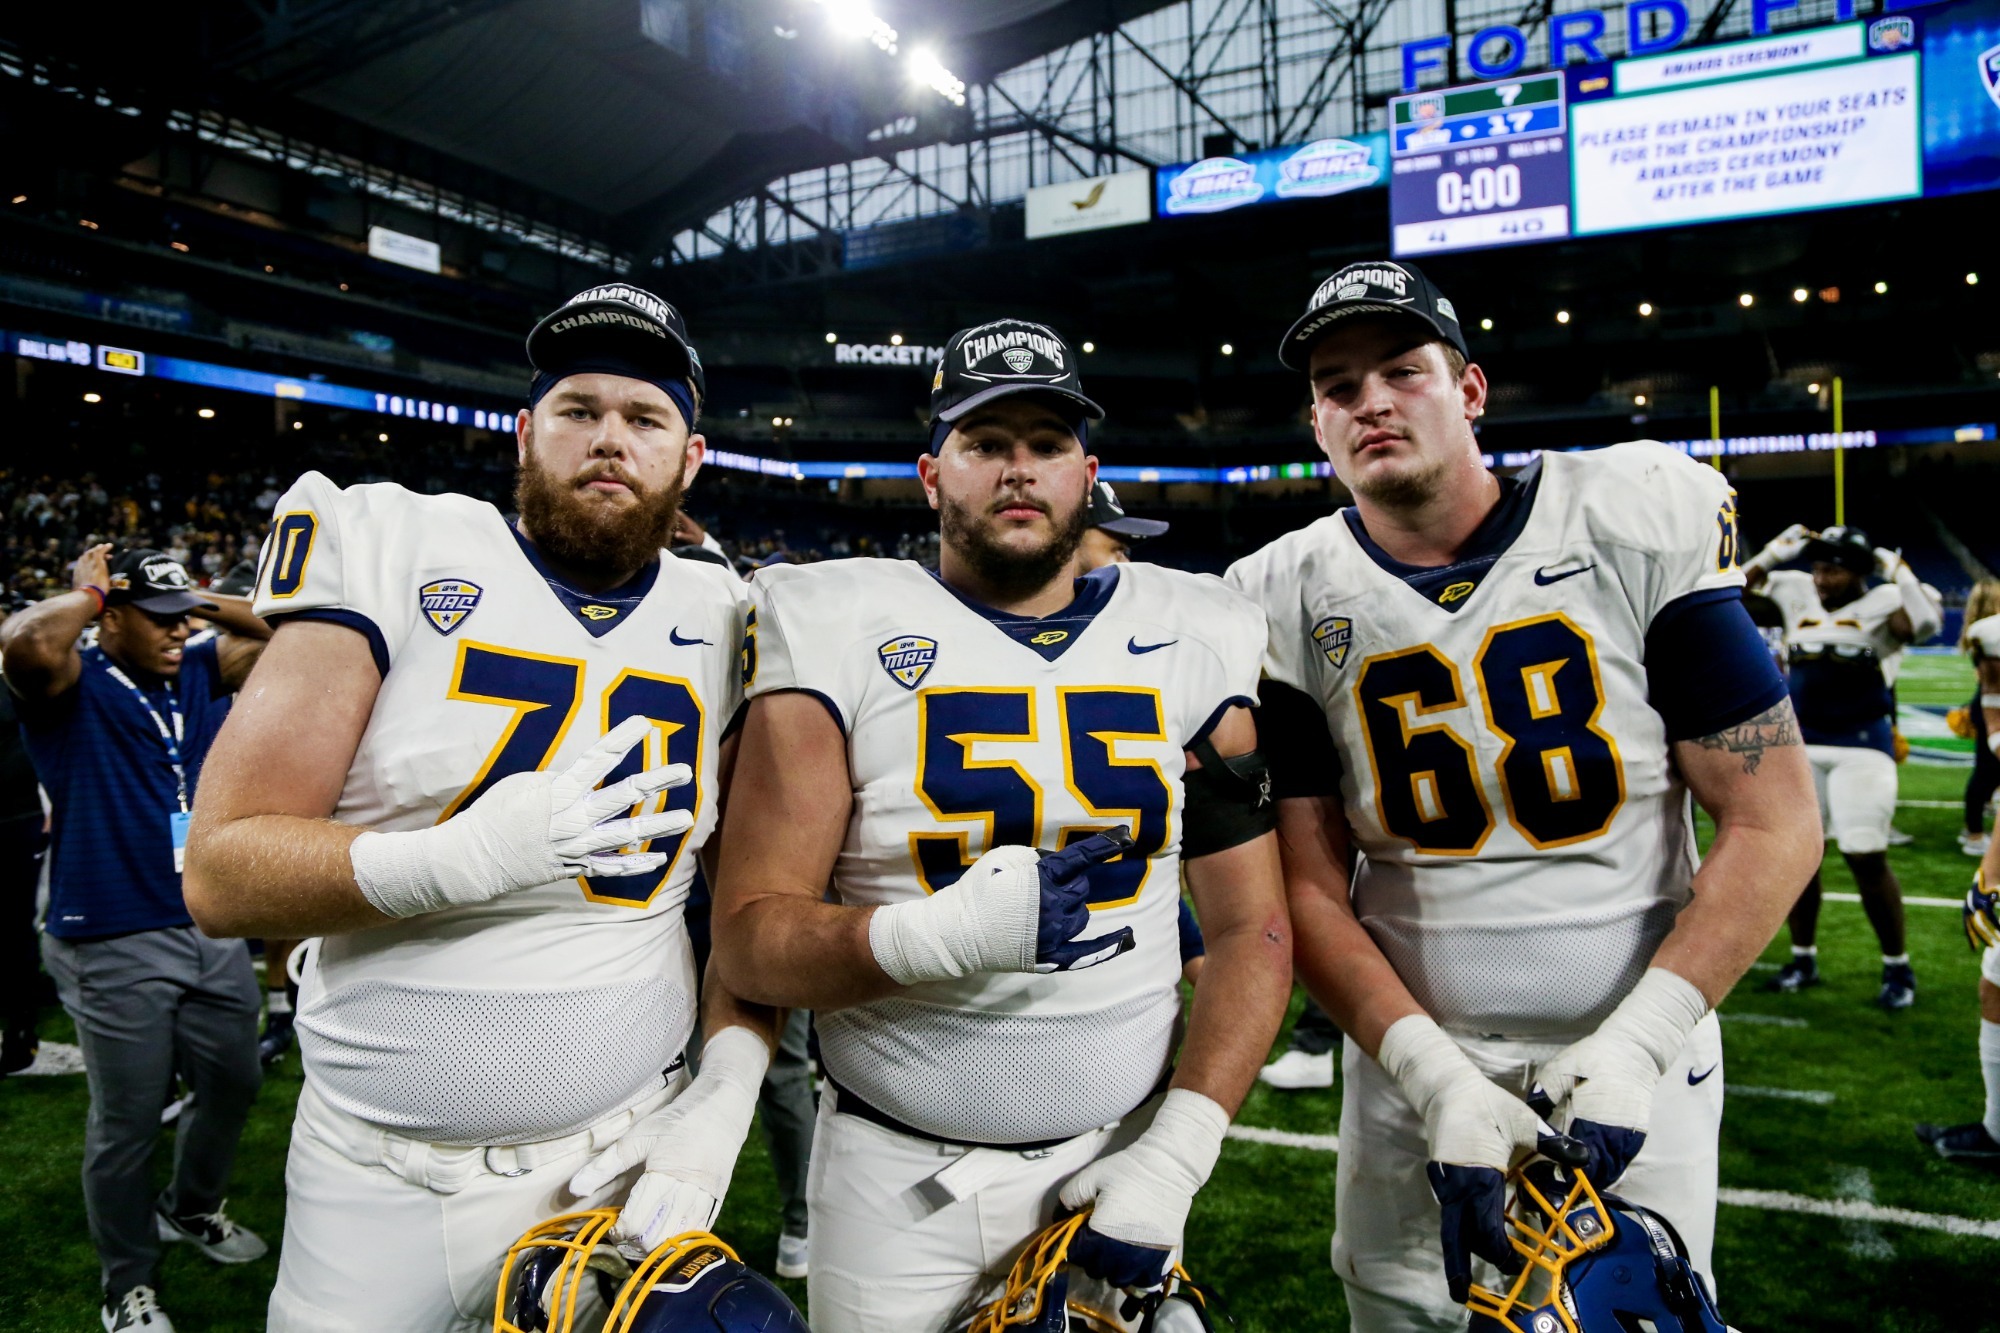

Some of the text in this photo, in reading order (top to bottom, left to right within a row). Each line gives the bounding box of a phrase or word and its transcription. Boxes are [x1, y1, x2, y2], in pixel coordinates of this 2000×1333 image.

[1402, 0, 1690, 93] FORD
[1728, 43, 1809, 66] CEREMONY
[1495, 84, 1522, 107] 7
[1487, 110, 1533, 137] 17
[1580, 87, 1907, 146] PLEASE REMAIN IN YOUR SEATS
[1610, 116, 1867, 165] FOR THE CHAMPIONSHIP
[1636, 143, 1842, 181] AWARDS CEREMONY
[1436, 164, 1521, 215] 0:00
[1653, 166, 1824, 201] AFTER THE GAME
[550, 312, 667, 339] CHAMPIONS
[835, 343, 924, 365] ROCKET
[963, 331, 1064, 370] CHAMPIONS
[375, 393, 459, 425] TOLEDO
[1727, 434, 1805, 455] FOOTBALL
[1807, 430, 1877, 450] CHAMPS
[255, 510, 319, 600] 0
[421, 595, 476, 609] MAC
[899, 641, 916, 649] 1946
[1320, 630, 1350, 651] MAC
[884, 650, 936, 669] MAC
[1352, 611, 1627, 857] 68
[434, 638, 705, 910] 70
[908, 684, 1172, 912] 55
